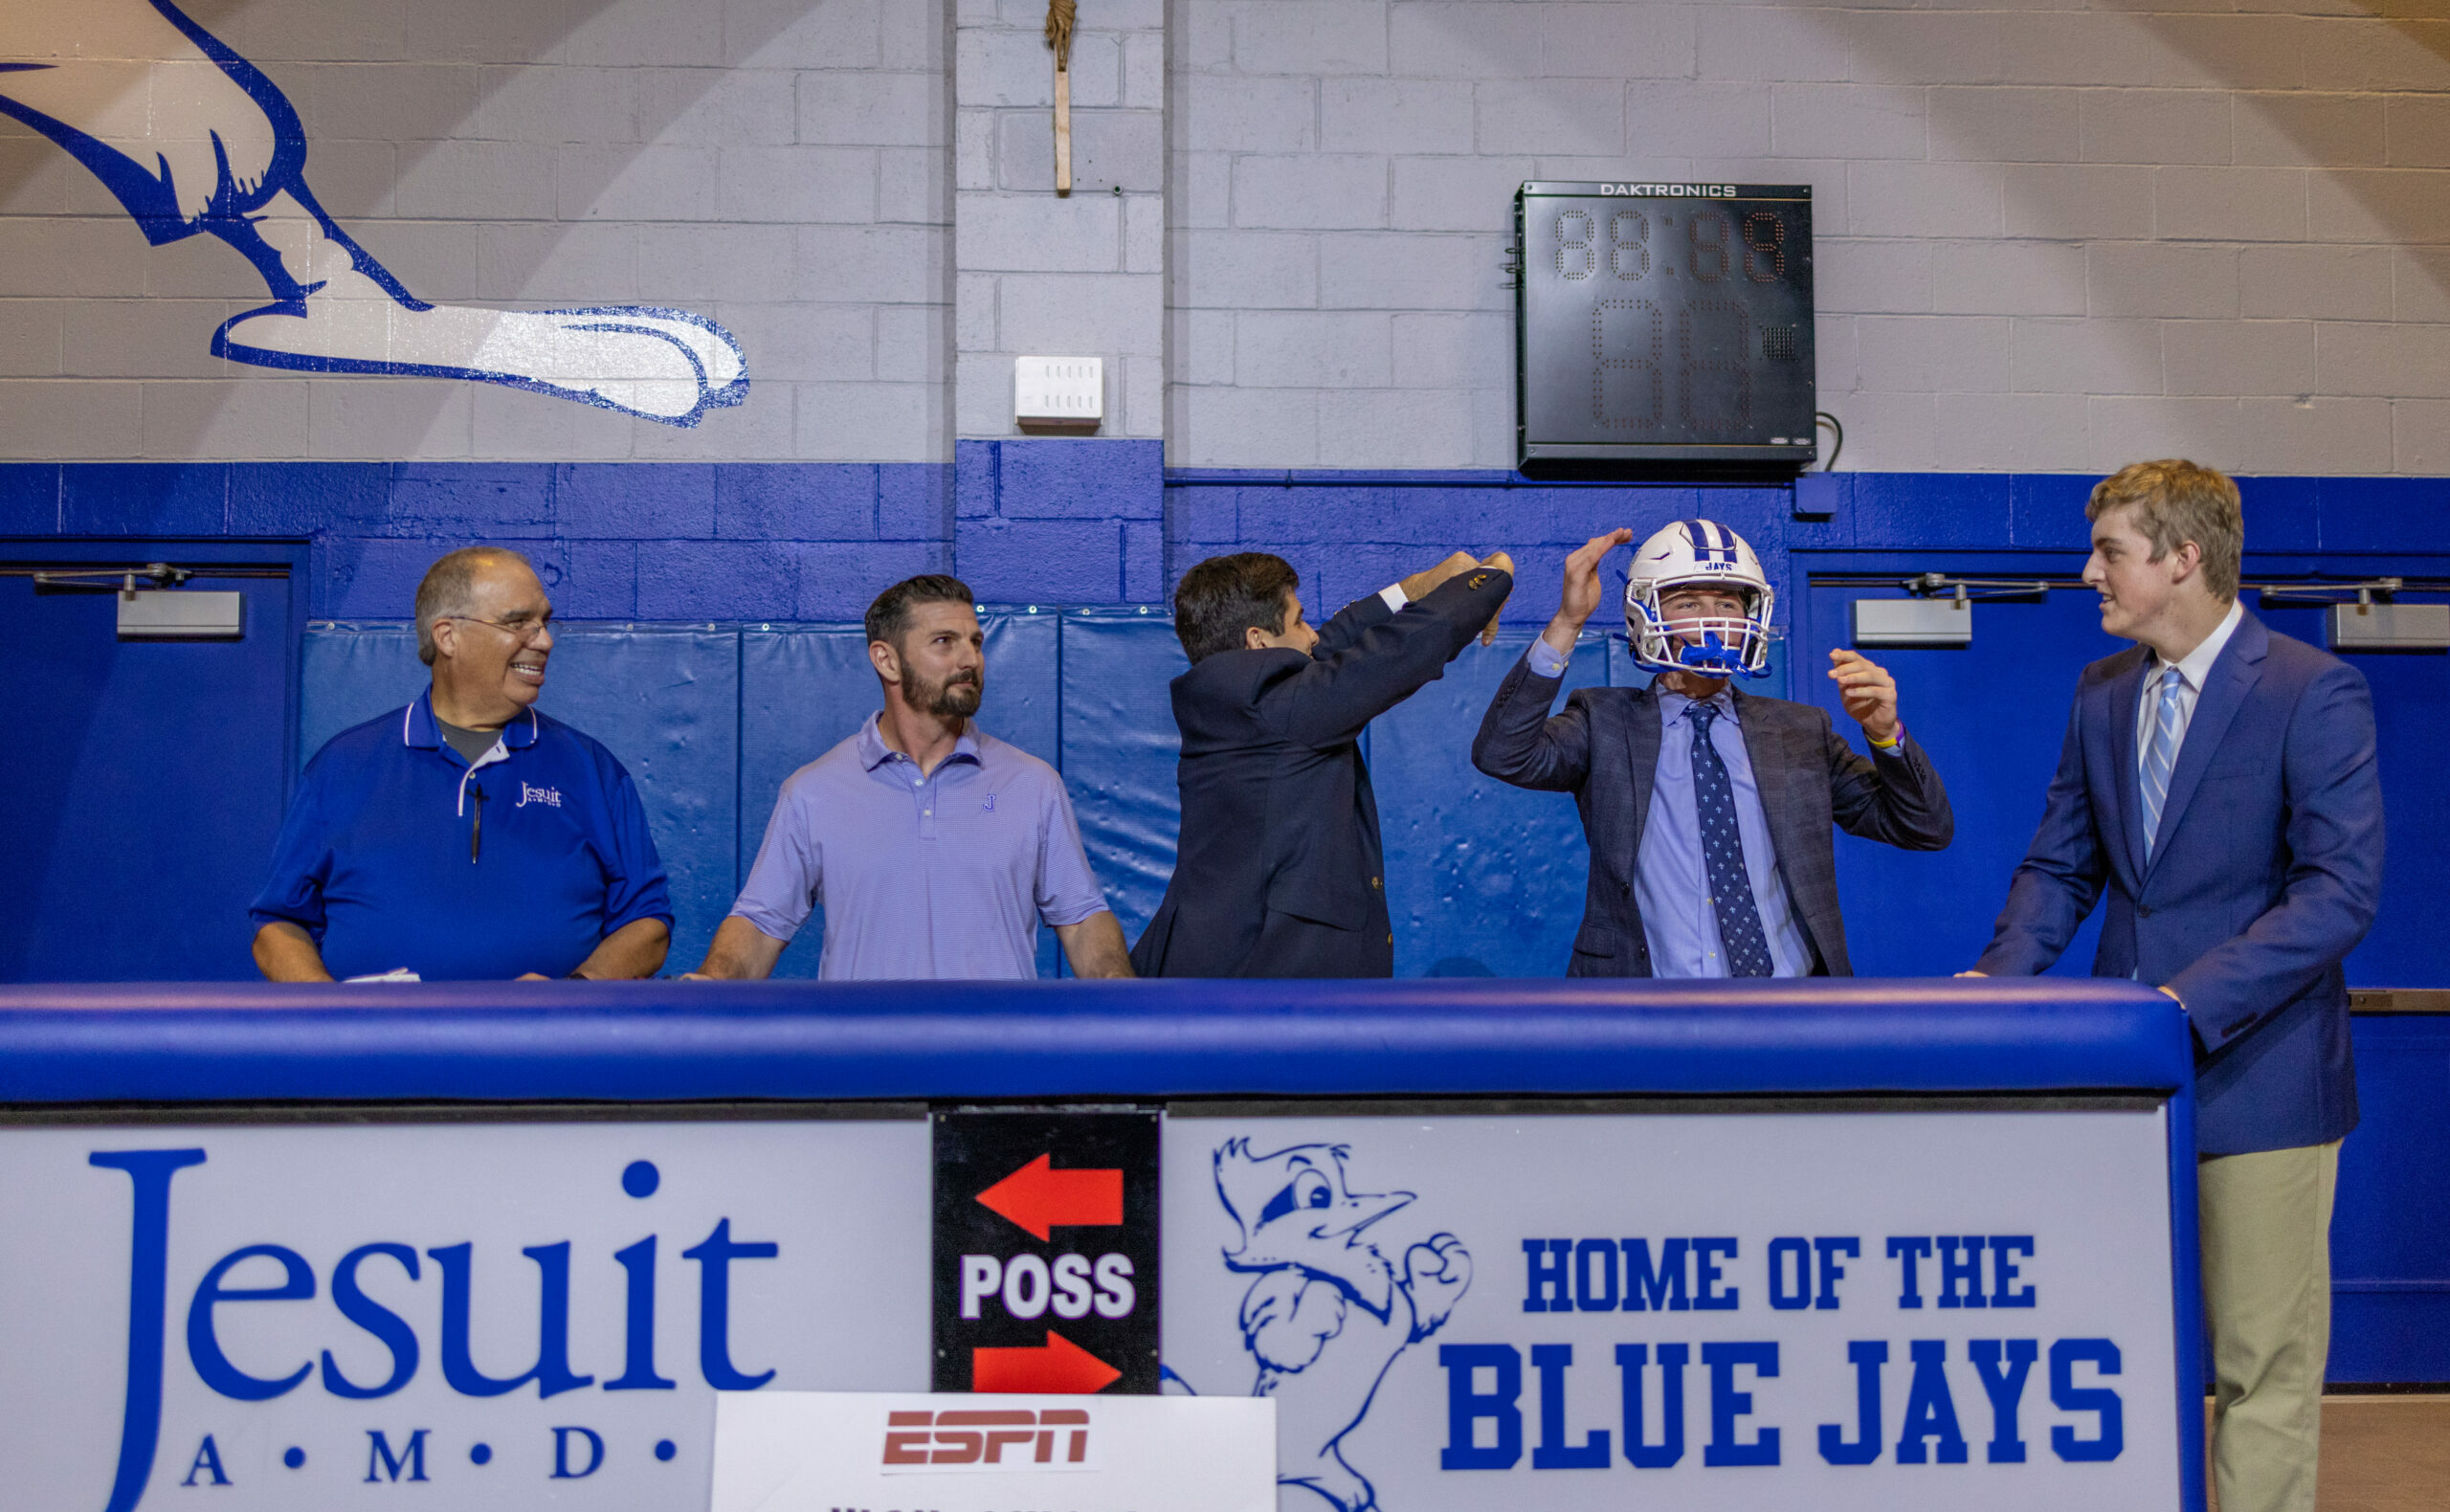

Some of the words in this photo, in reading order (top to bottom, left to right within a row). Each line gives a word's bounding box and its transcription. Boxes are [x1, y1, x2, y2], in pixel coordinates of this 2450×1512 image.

[1600, 184, 1737, 197] DAKTRONICS
[1705, 562, 1732, 571] JAYS
[515, 781, 562, 808] Jesuit
[961, 1253, 1136, 1320] POSS
[1522, 1237, 1739, 1313] HOME
[1768, 1236, 1860, 1311] OF
[1886, 1235, 2036, 1309] THE
[88, 1148, 778, 1512] Jesuit
[1438, 1342, 1781, 1471] BLUE
[1817, 1338, 2124, 1465] JAYS
[882, 1410, 1089, 1464] ESPN
